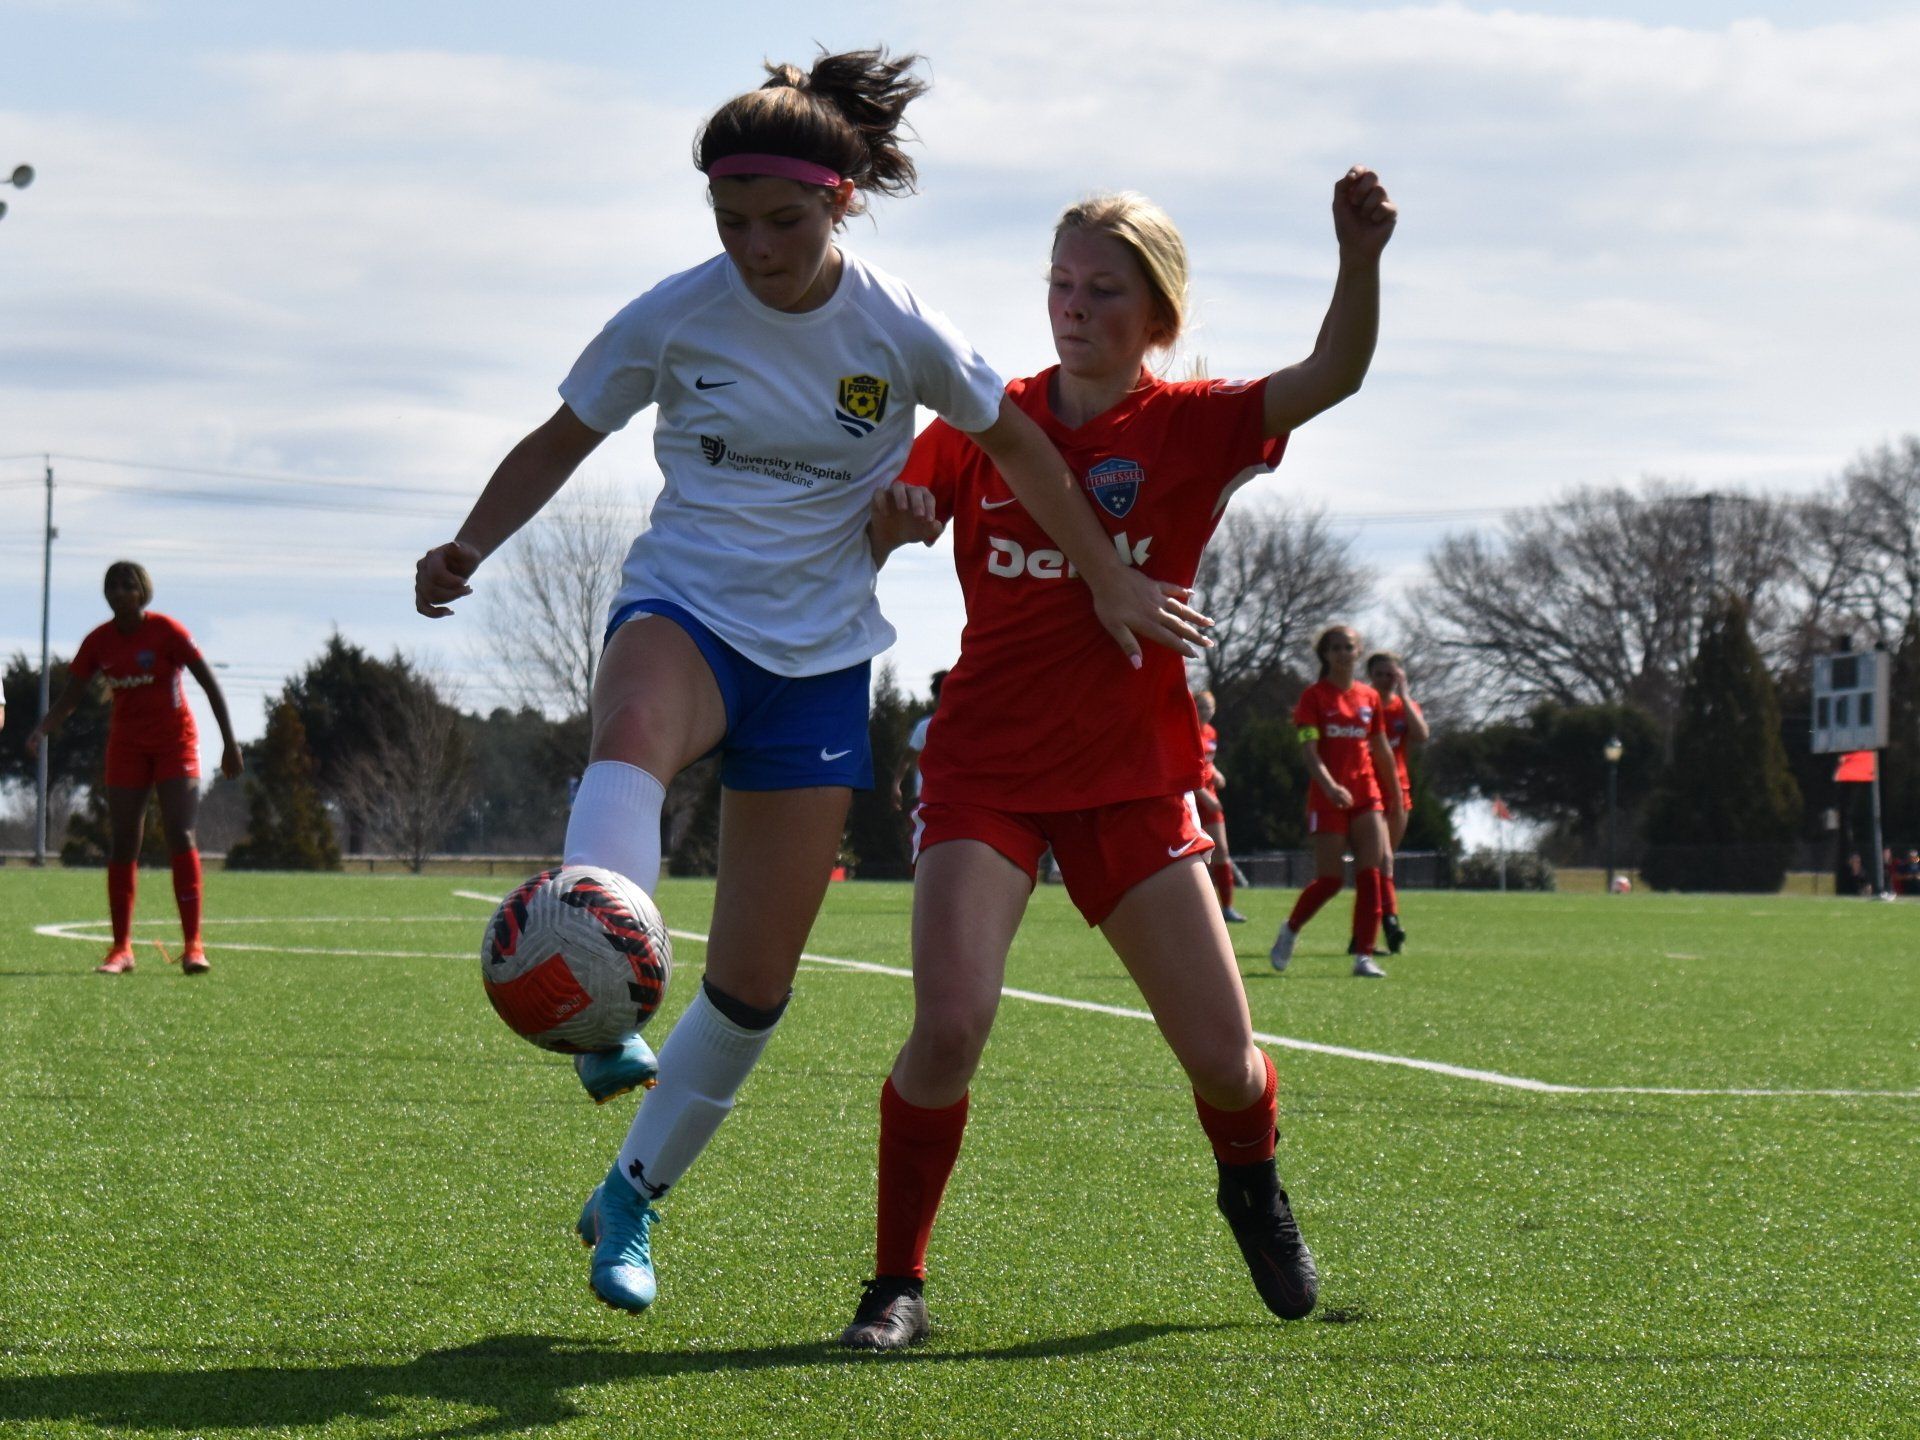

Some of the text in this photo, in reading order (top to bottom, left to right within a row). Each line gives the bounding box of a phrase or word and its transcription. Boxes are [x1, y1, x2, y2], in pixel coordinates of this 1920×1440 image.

[848, 383, 881, 396] FORCE
[727, 450, 852, 481] University Hospitals
[728, 462, 814, 489] ports Medicine
[1089, 470, 1142, 488] TENNESSEE
[987, 531, 1153, 579] Dek
